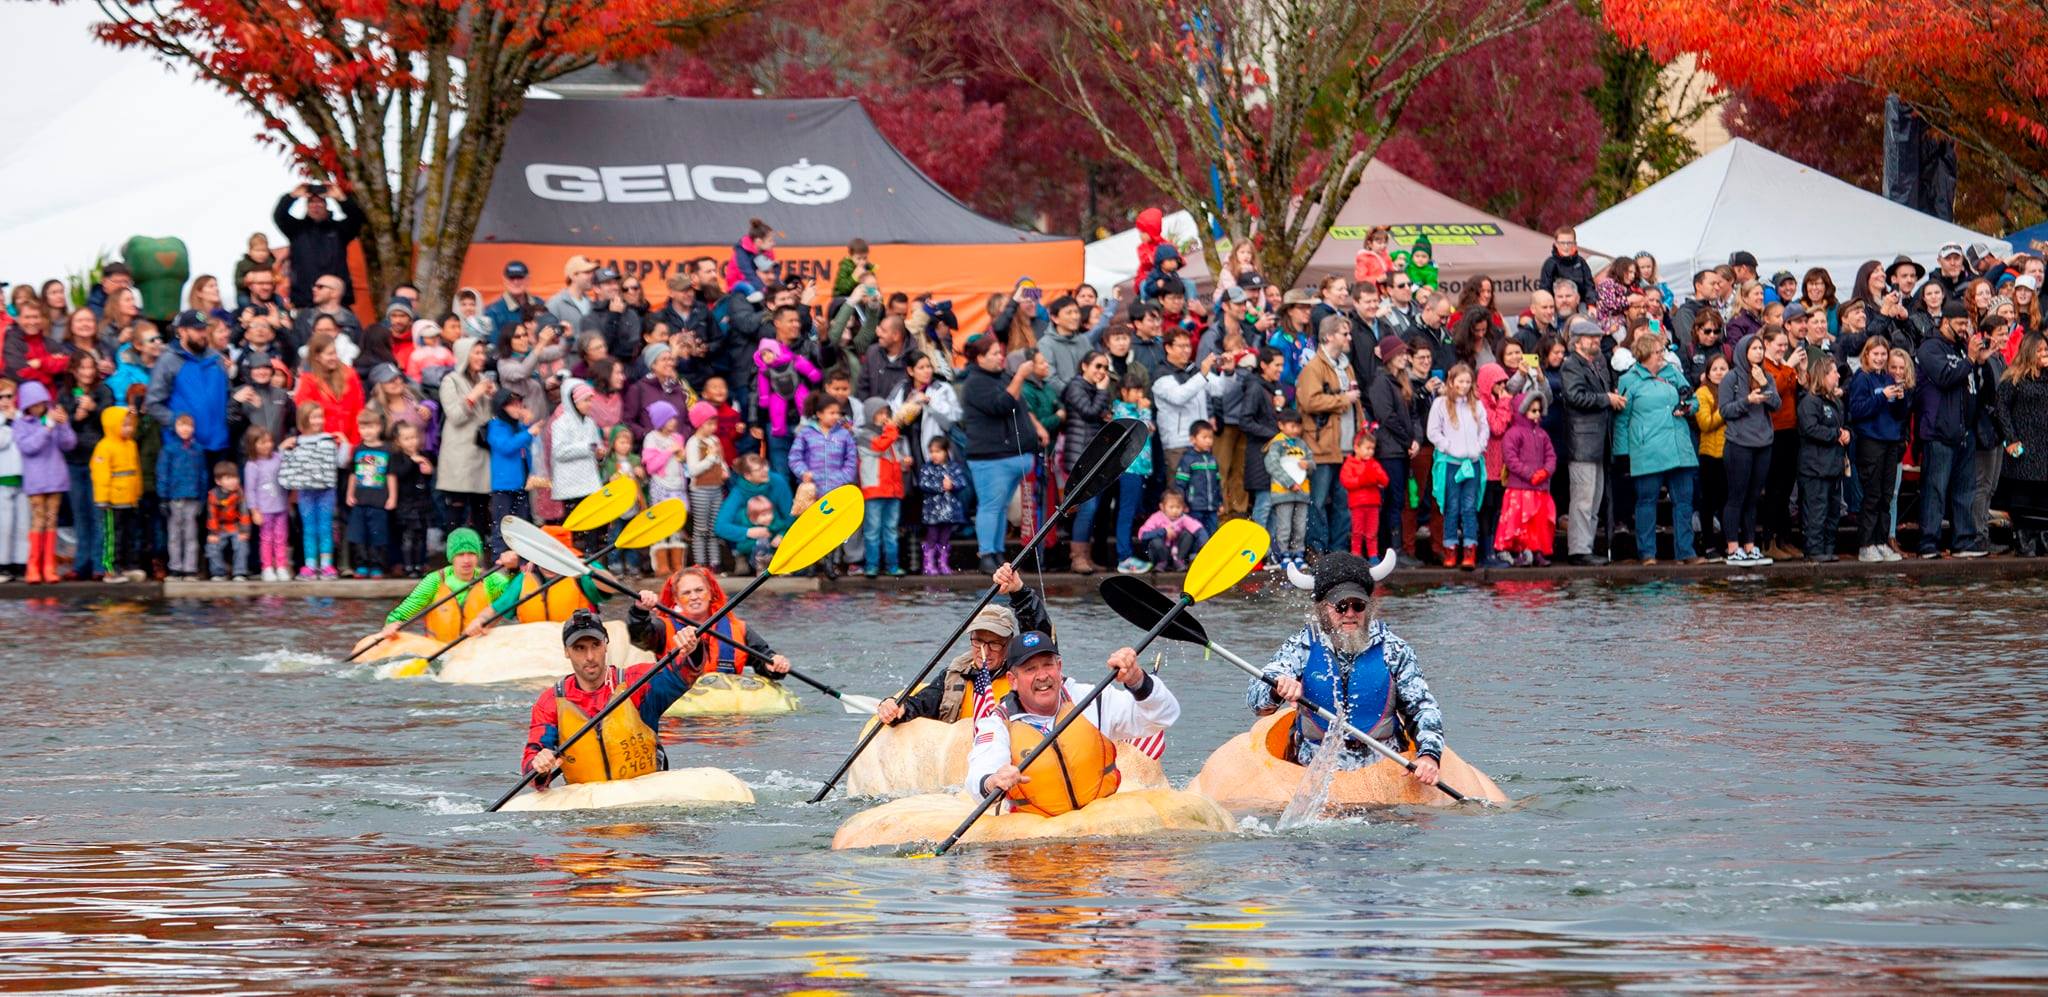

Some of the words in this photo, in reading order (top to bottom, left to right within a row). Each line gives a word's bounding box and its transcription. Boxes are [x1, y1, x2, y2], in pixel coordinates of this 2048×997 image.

[1391, 224, 1497, 236] SEASONS
[597, 259, 672, 281] APPY
[620, 732, 644, 750] 503
[619, 753, 653, 777] 0464
